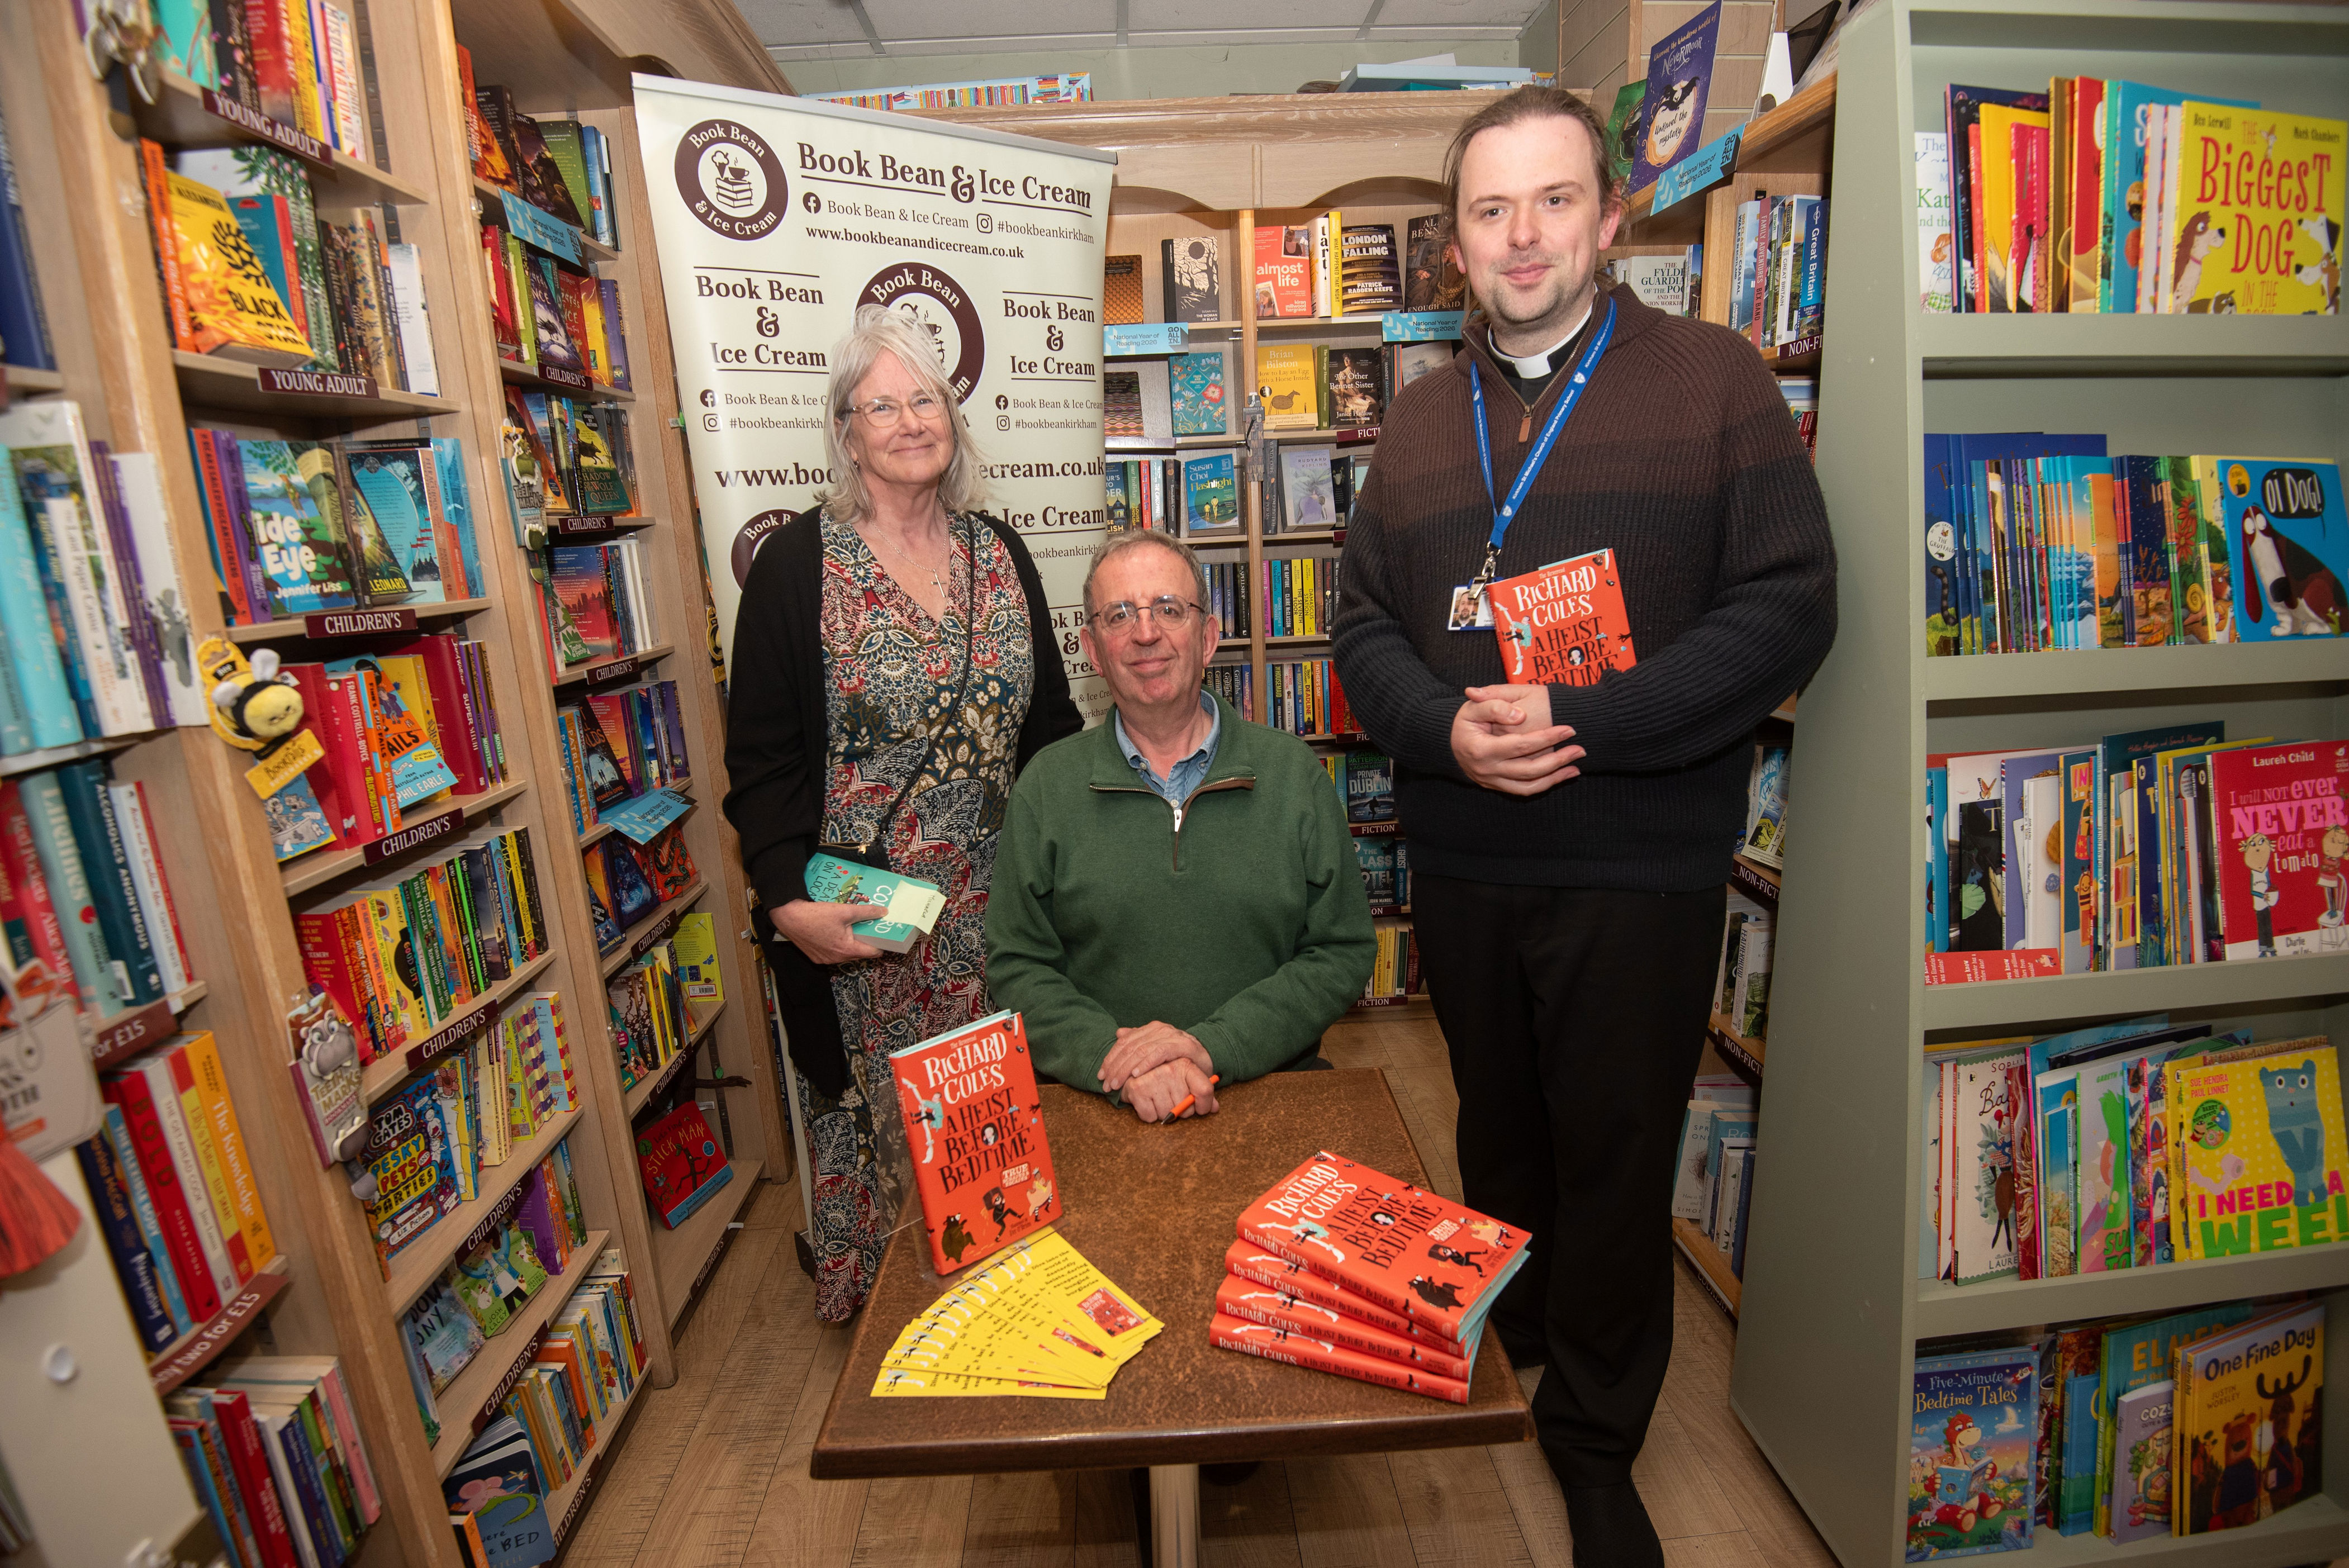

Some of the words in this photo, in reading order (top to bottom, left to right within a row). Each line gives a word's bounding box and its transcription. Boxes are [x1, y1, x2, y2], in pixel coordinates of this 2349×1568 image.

[213, 93, 273, 139] YOUNG
[271, 120, 323, 160] ADULT
[689, 123, 727, 150] Book
[730, 125, 765, 158] Bean
[1725, 134, 1735, 146] GO
[2241, 120, 2258, 145] THE
[1721, 153, 1731, 165] IN.
[1722, 144, 1733, 155] ALL
[796, 142, 873, 178] Book
[879, 154, 946, 188] Bean
[951, 165, 975, 203] &
[979, 168, 1015, 196] Ice
[1022, 175, 1091, 209] Cream
[695, 200, 708, 214] &
[706, 209, 730, 231] Ice
[735, 210, 777, 236] Cream
[828, 200, 862, 216] Book
[865, 204, 895, 220] Bean
[899, 209, 909, 221] &
[912, 210, 930, 224] Ice
[932, 211, 969, 229] Cream
[806, 227, 1025, 259] www.bookbeanandicecream.co.uk
[997, 220, 1094, 244] #bookbeankirkham
[1342, 234, 1387, 245] LONDON
[1810, 227, 1820, 260] Great
[1342, 246, 1388, 258] FALLING
[1256, 262, 1303, 275] almost
[1278, 274, 1299, 287] life
[1807, 263, 1818, 301] Britain
[695, 274, 762, 300] Book
[767, 279, 824, 305] Bean
[870, 268, 917, 303] Book
[920, 269, 961, 309] Bean
[226, 288, 286, 321] BLACK
[1003, 298, 1052, 319] Book
[1057, 301, 1095, 323] Bean
[262, 321, 305, 346] STAR
[756, 306, 780, 338] &
[1046, 324, 1064, 351] &
[710, 342, 747, 364] Ice
[754, 343, 827, 367] Cream
[1010, 355, 1038, 374] Ice
[1042, 357, 1096, 376] Cream
[1266, 360, 1298, 369] Bilston
[1269, 350, 1293, 359] Brian
[272, 370, 324, 393] YOUNG
[326, 374, 368, 396] ADULT
[545, 365, 586, 388] CHILDREN'S
[725, 393, 757, 405] Book
[760, 394, 788, 406] Bean
[791, 395, 800, 406] &
[802, 394, 818, 406] Ice
[1013, 398, 1036, 410] Book
[1038, 398, 1061, 410] Bean
[1063, 398, 1071, 410] &
[1072, 398, 1084, 410] Ice
[1085, 398, 1103, 410] Cream
[1014, 418, 1097, 430] #bookbeankirkham
[1189, 463, 1213, 473] Susan
[1189, 471, 1208, 481] Choi
[590, 491, 620, 504] QUEEN
[1190, 477, 1232, 492] Flashlight
[567, 515, 607, 531] CHILDREN'S
[264, 542, 317, 583] Eye
[274, 582, 321, 600] Jennifer
[322, 581, 343, 593] Liss
[1512, 565, 1597, 613] RICHARD
[324, 611, 402, 634] CHILDREN'S
[1532, 594, 1593, 628] COLES
[1534, 636, 1545, 654] A
[1545, 616, 1602, 648] HEIST
[596, 659, 633, 681] CHILDREN'S
[2253, 755, 2286, 767] Lauren
[2289, 751, 2315, 763] Child
[1349, 777, 1392, 795] DUBLIN
[1357, 769, 1382, 779] PRIVATE
[395, 787, 418, 805] PHIL
[418, 773, 447, 793] EARLE
[2229, 791, 2236, 806] I
[2239, 789, 2260, 804] will
[2264, 786, 2289, 801] NOT
[2291, 776, 2338, 799] ever
[1361, 824, 1395, 834] FICTION
[2231, 796, 2348, 839] NEVER
[381, 815, 452, 857] CHILDREN'S
[2274, 850, 2319, 873] tomato
[638, 915, 672, 952] CHILDREN'S
[1357, 997, 1389, 1006] FICTION
[115, 1019, 146, 1047] £15
[422, 1008, 487, 1059] CHILDREN'S
[656, 1049, 688, 1095] CHILDREN'S
[922, 1031, 1008, 1089] RICHARD
[943, 1063, 1005, 1105] COLES
[2189, 1077, 2205, 1088] SUE
[2206, 1073, 2229, 1086] HENDRA
[2190, 1086, 2209, 1099] PAUL
[2210, 1084, 2230, 1096] LINNET
[373, 1106, 405, 1128] TOM
[946, 1114, 958, 1137] A
[958, 1086, 1015, 1126] HEIST
[372, 1112, 411, 1146] GATES
[371, 1135, 421, 1177] PESKY
[646, 1137, 676, 1174] STICK
[678, 1122, 705, 1145] MAN
[937, 1127, 1035, 1195] BEDTIME
[380, 1157, 417, 1194] PETS
[374, 1166, 434, 1220] PARTIES
[1264, 1163, 1340, 1219] RICHARD
[1299, 1179, 1359, 1219] COLES
[2197, 1192, 2206, 1218] I
[2215, 1180, 2294, 1216] NEED
[2327, 1170, 2346, 1195] A
[467, 1181, 523, 1252] CHILDREN'S
[1326, 1218, 1340, 1237] A
[1334, 1185, 1376, 1225] HEIST
[1359, 1200, 1444, 1270] BEDTIME
[177, 1336, 212, 1374] two
[201, 1317, 234, 1344] for
[227, 1291, 261, 1319] £15
[2204, 1353, 2243, 1382] One
[2244, 1341, 2281, 1372] Fine
[2284, 1325, 2318, 1357] Day
[485, 1336, 539, 1417] CHILDREN'S
[1928, 1370, 2004, 1391] Five-Minute
[1914, 1390, 1973, 1415] Bedtime
[1977, 1385, 2019, 1408] Tales
